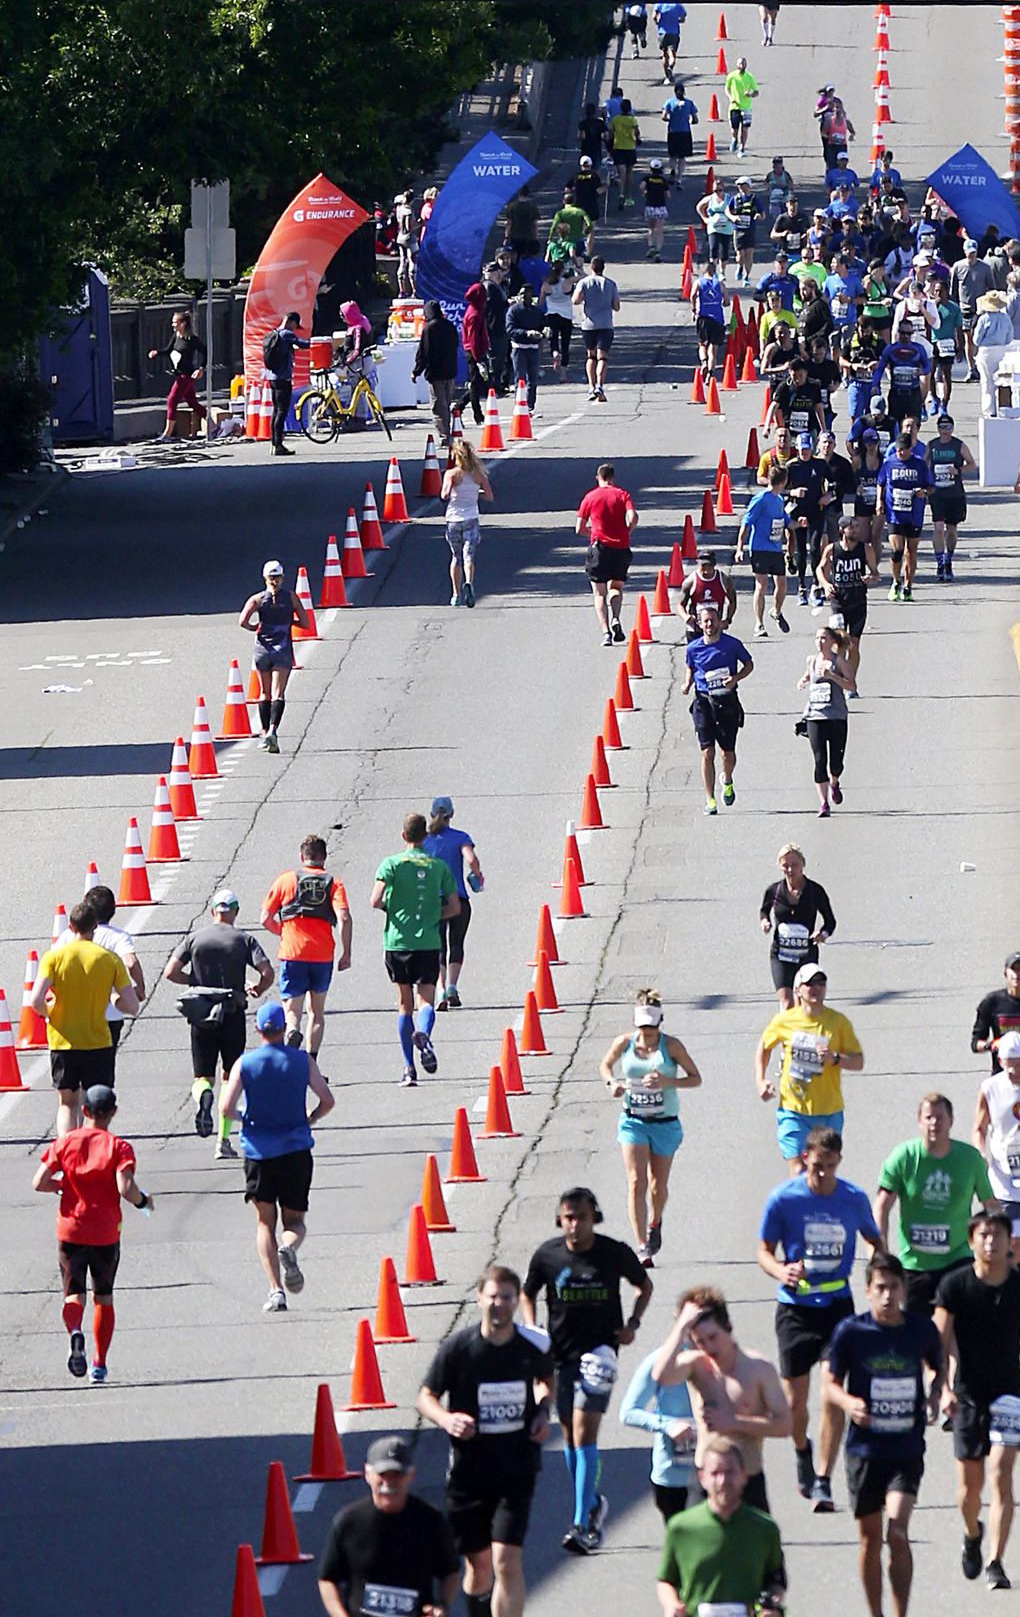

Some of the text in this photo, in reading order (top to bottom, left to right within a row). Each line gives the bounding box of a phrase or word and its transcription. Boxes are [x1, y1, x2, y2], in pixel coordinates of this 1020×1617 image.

[472, 165, 521, 177] WATER
[941, 174, 987, 186] WATER
[306, 209, 355, 220] ENDURANCE
[631, 1094, 663, 1104] 22536
[479, 1403, 525, 1419] 21007
